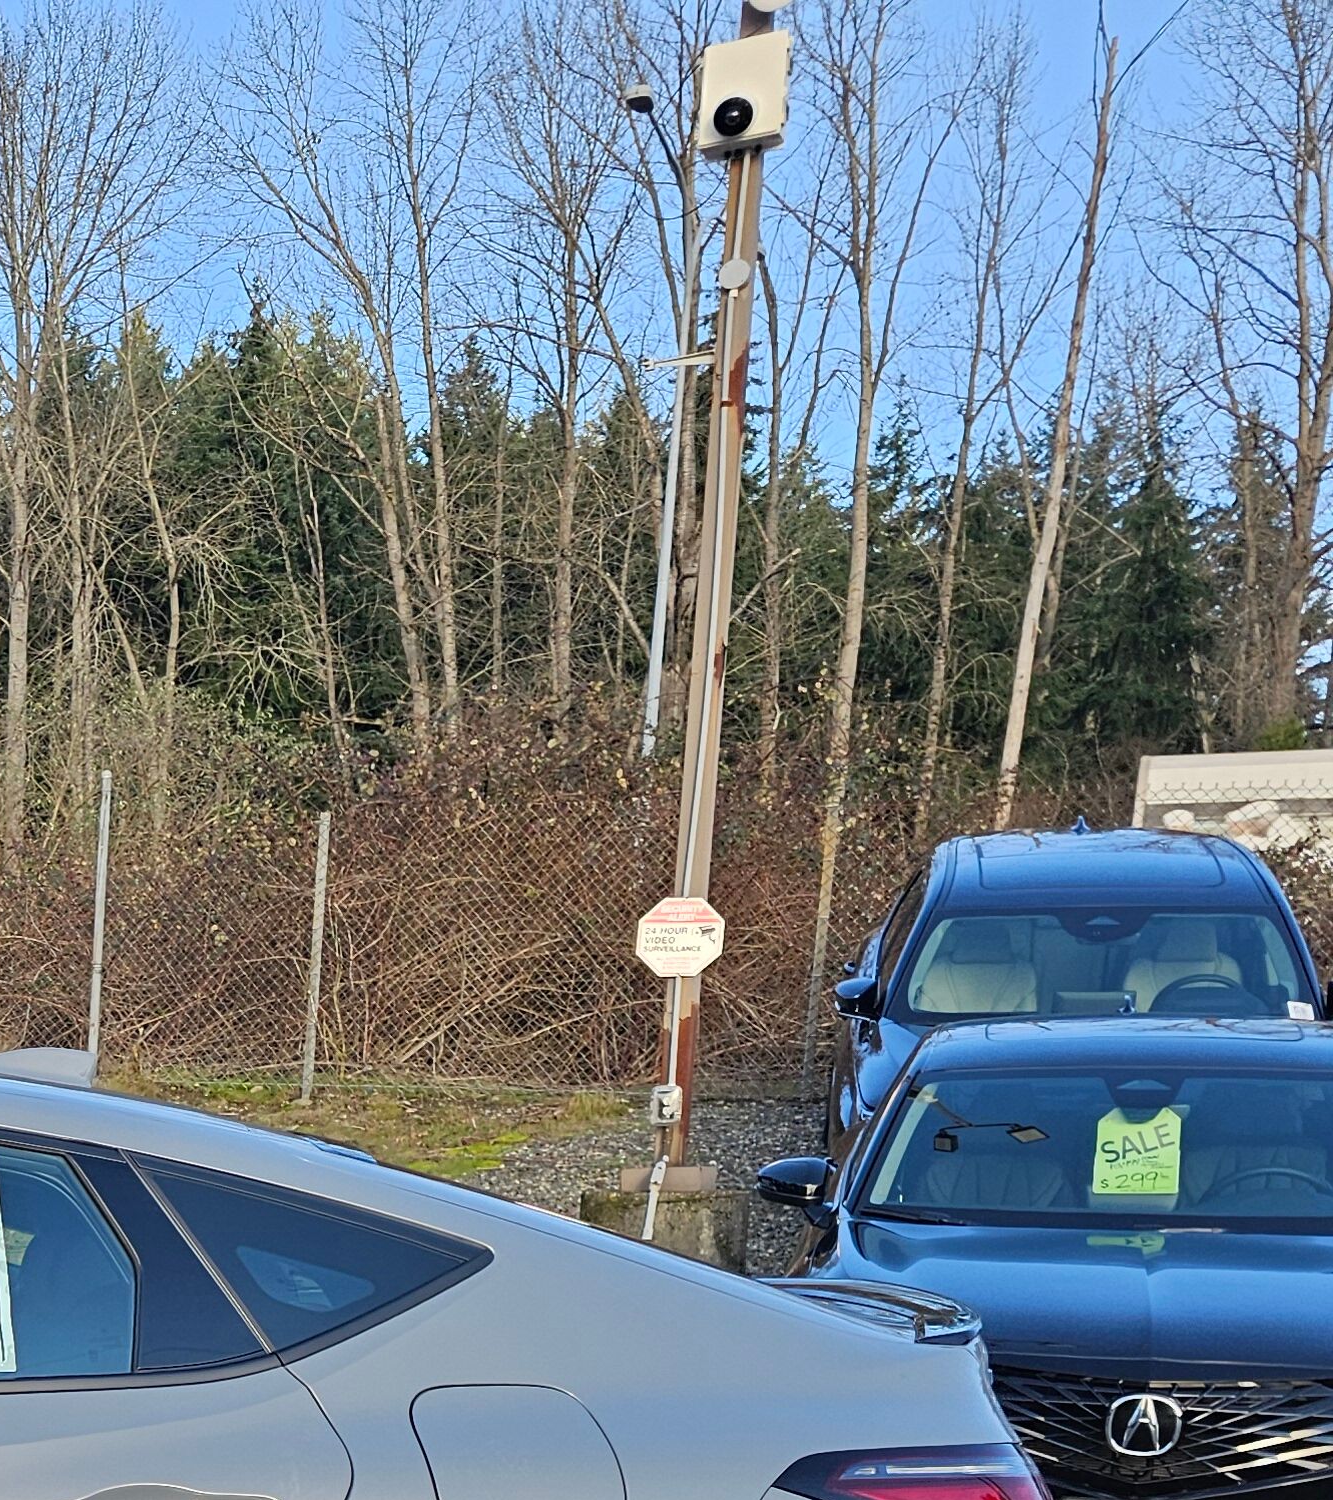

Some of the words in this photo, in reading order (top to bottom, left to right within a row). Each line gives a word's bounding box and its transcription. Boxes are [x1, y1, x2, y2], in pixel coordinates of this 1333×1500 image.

[645, 927, 656, 935] 24
[660, 927, 688, 935] HOUR
[645, 936, 675, 944] VIDEO
[643, 945, 701, 953] SURVEILLANCE
[1100, 1123, 1176, 1163] SALE
